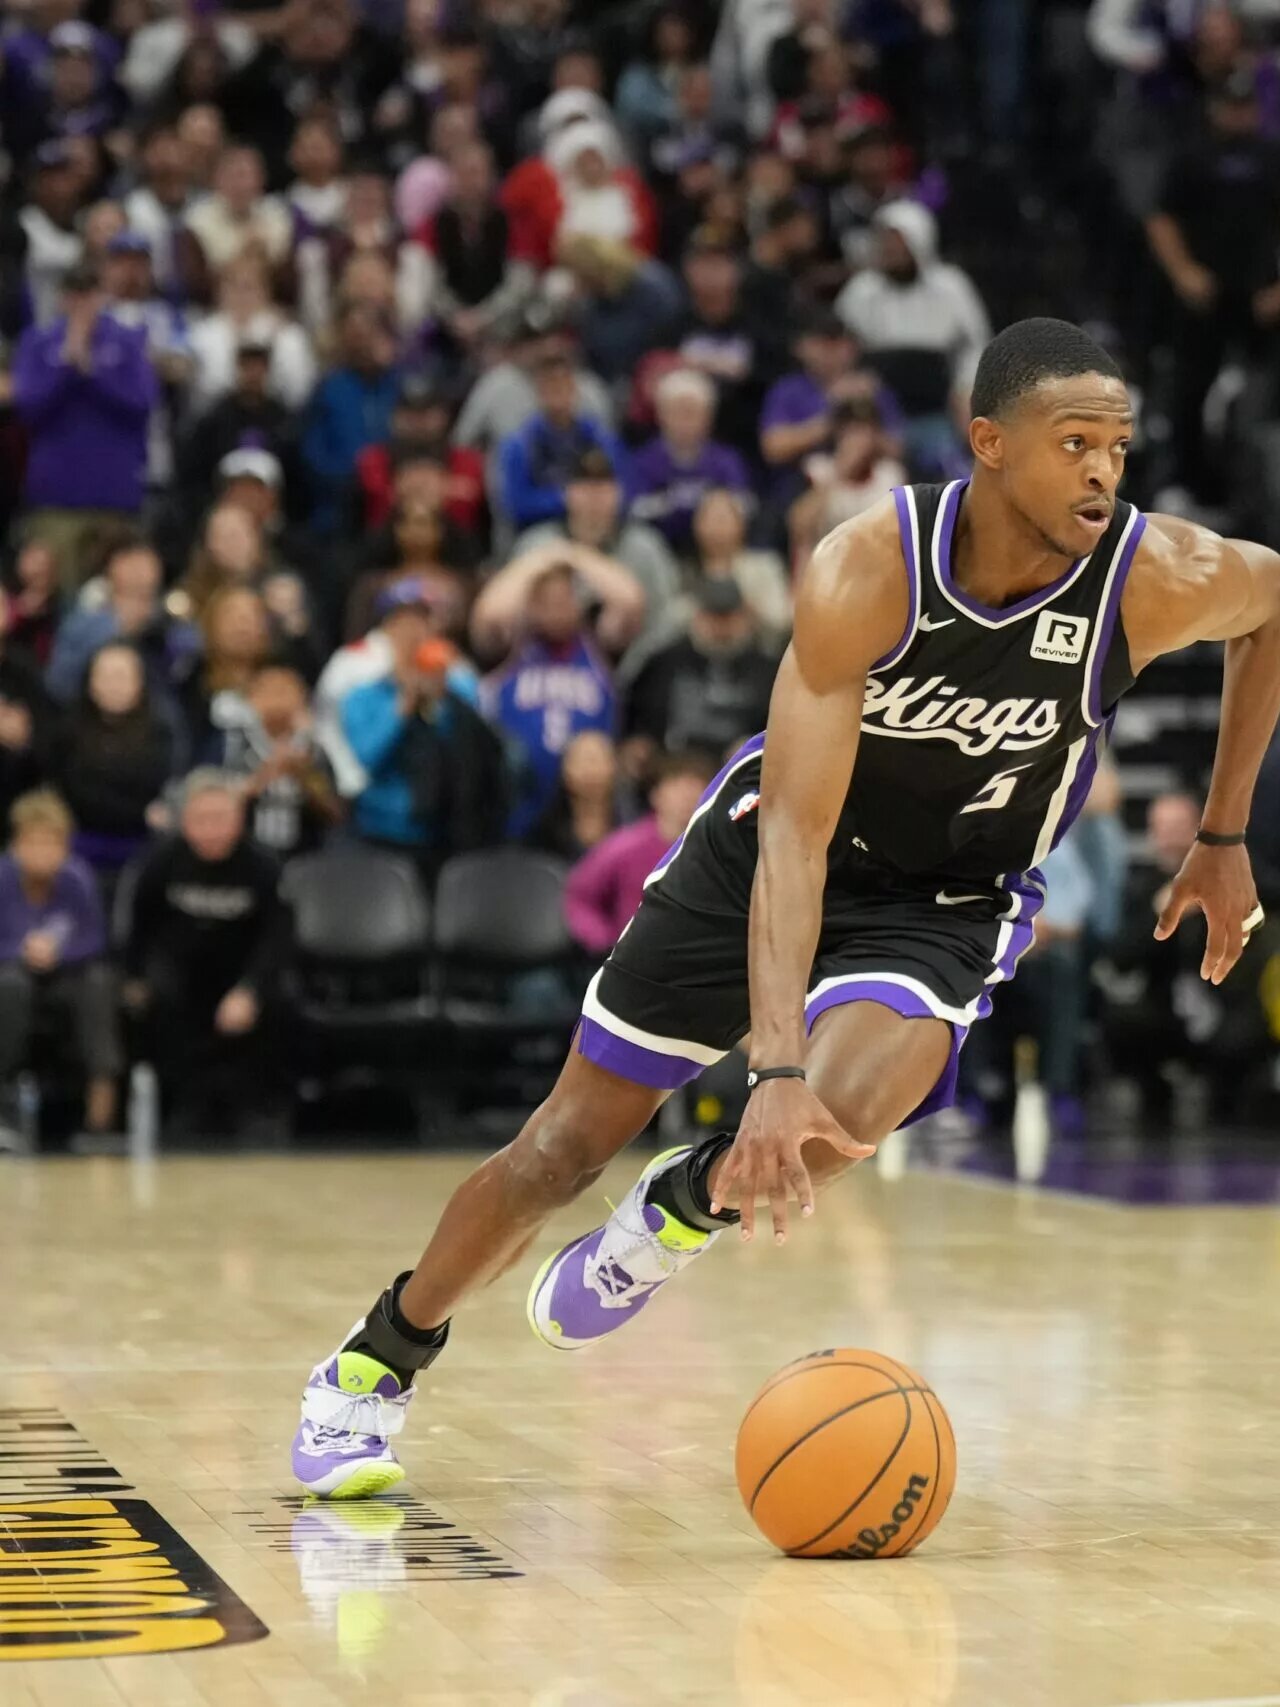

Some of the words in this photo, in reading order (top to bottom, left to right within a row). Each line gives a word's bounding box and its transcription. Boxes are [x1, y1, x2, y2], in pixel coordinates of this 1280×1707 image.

[1034, 646, 1079, 659] REVIVER
[1046, 618, 1078, 647] R
[860, 674, 1061, 757] Kings
[959, 762, 1035, 815] 5
[832, 1473, 930, 1560] ilson
